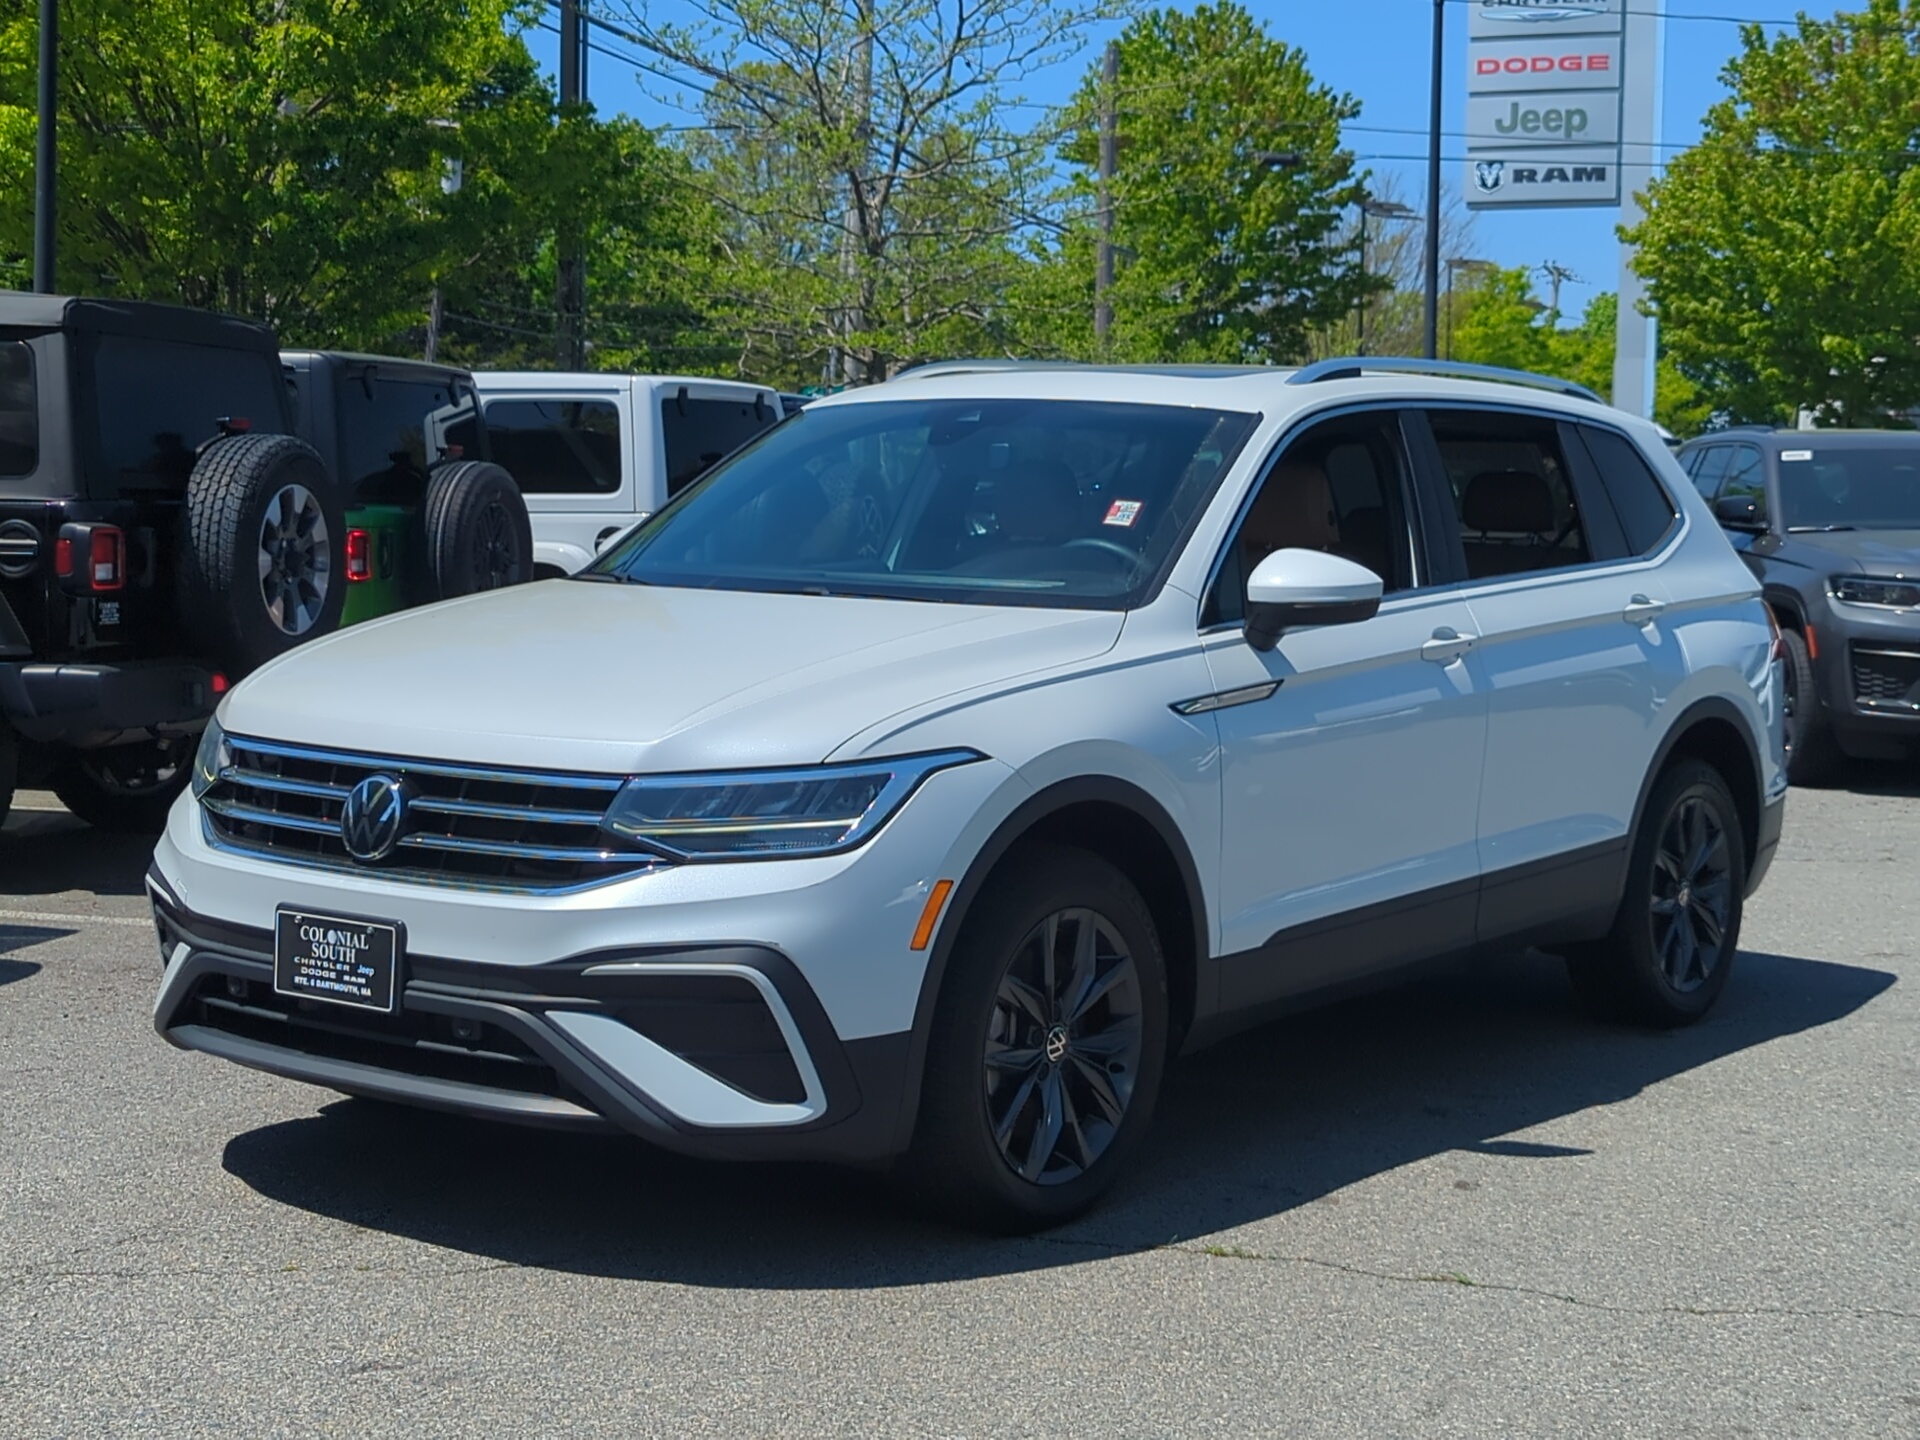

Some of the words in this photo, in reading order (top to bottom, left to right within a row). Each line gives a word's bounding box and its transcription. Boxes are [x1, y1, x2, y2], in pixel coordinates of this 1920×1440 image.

[1477, 55, 1609, 75] DODGE
[1495, 102, 1588, 138] Jeep
[1512, 167, 1606, 183] RAM
[300, 925, 369, 949] COLONIAL
[311, 942, 356, 963] SOUTH
[294, 956, 350, 971] CHRYSLER
[300, 966, 337, 979] DODGE
[361, 987, 371, 996] MA
